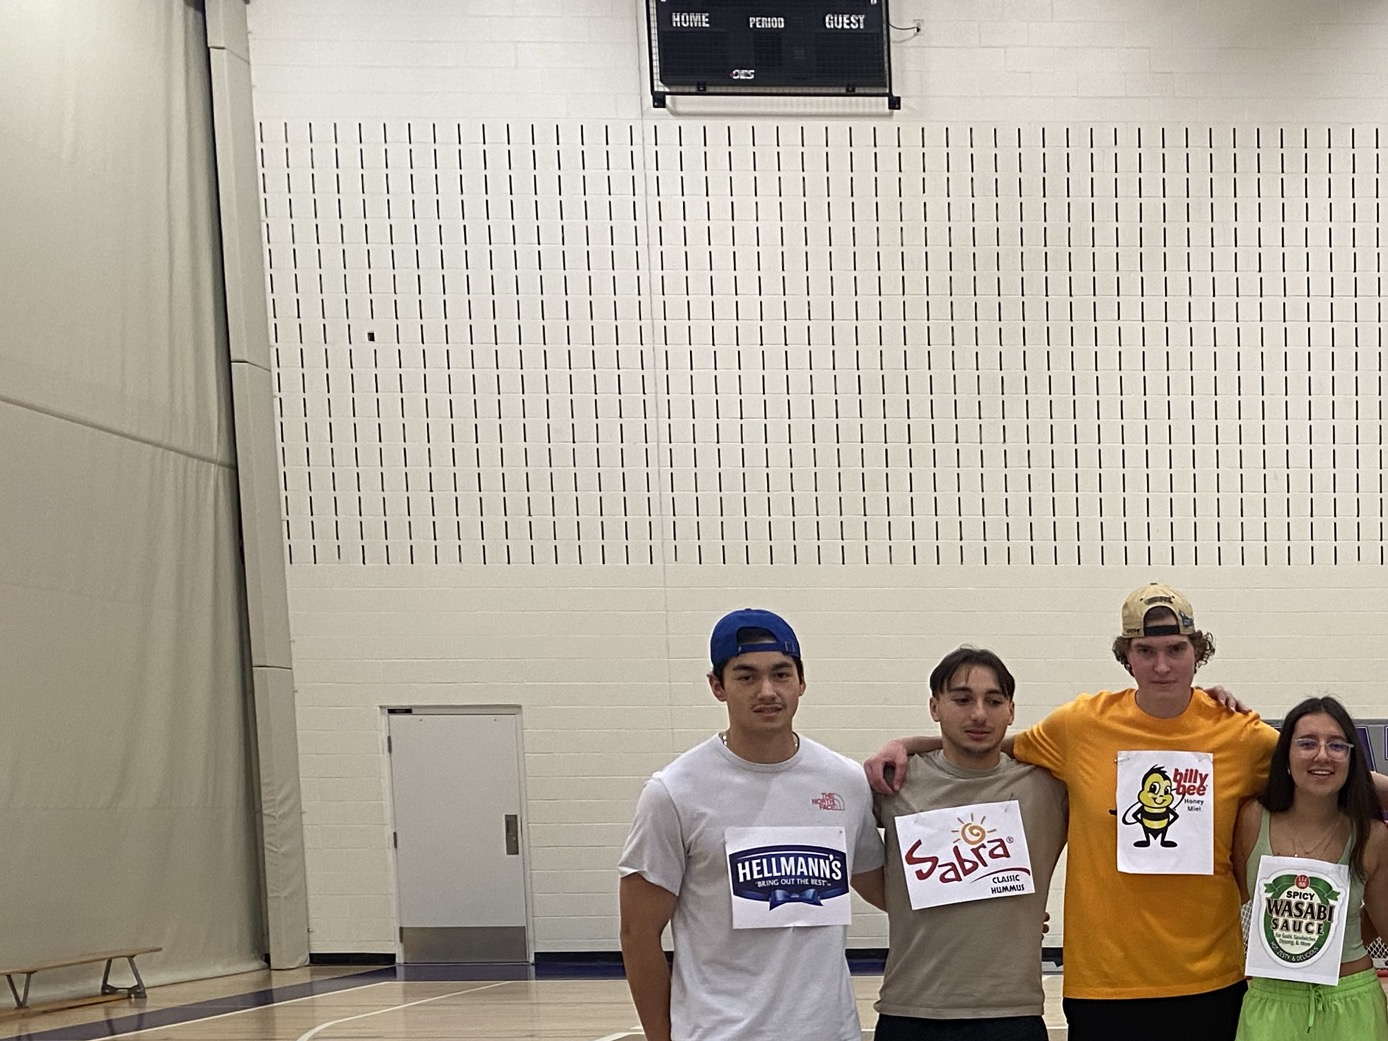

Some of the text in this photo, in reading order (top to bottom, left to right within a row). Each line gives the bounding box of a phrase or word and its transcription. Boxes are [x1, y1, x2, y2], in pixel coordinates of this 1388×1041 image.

[672, 13, 710, 28] HOME
[749, 17, 785, 29] PERIOD
[825, 14, 866, 29] GUEST
[1172, 767, 1210, 784] billy
[1175, 781, 1207, 796] bee
[1183, 798, 1205, 806] Honey
[904, 837, 1012, 884] Sabra
[737, 854, 842, 883] HELLMANN'S
[992, 873, 1021, 884] CLASSIC
[990, 884, 1025, 894] HUMMUS
[1286, 890, 1316, 901] SPICY
[1265, 897, 1335, 923] WASABI
[1271, 918, 1324, 936] SAUCE
